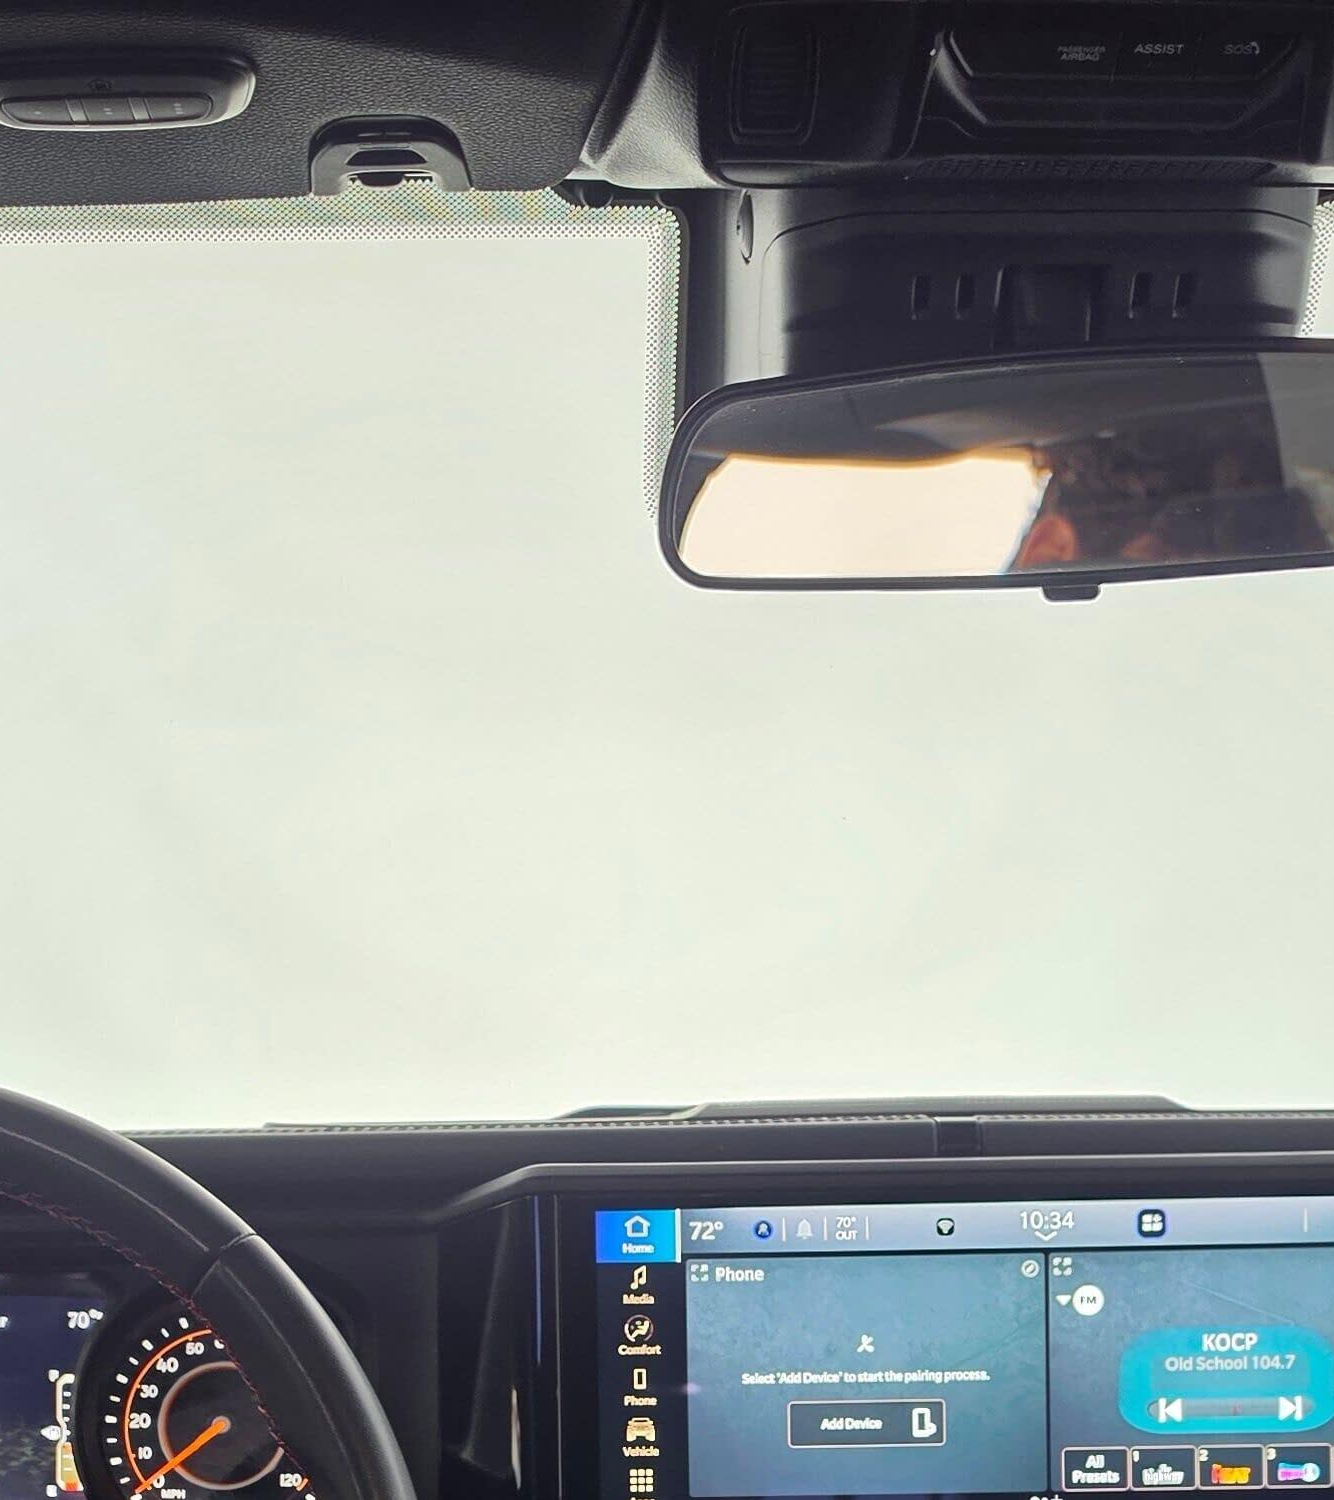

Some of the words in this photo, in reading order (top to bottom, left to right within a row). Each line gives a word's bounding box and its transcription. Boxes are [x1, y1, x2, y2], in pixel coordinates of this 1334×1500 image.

[1134, 43, 1184, 55] ASSIST
[1223, 43, 1252, 55] SOS
[836, 1216, 857, 1228] 70°
[1020, 1211, 1075, 1231] 10:34
[689, 1220, 724, 1240] 72°
[835, 1230, 858, 1241] OUT
[622, 1243, 655, 1254] Home
[715, 1266, 765, 1282] Phone
[623, 1294, 655, 1305] Media
[1080, 1295, 1097, 1305] FM
[1201, 1332, 1259, 1352] KOCP
[186, 1343, 204, 1355] 50
[617, 1344, 662, 1356] Comfort
[156, 1357, 179, 1373] 40
[1165, 1356, 1194, 1372] Old
[1196, 1355, 1250, 1372] School
[1252, 1354, 1296, 1371] 104.7
[742, 1373, 776, 1385] Select
[844, 1373, 856, 1383] to
[858, 1371, 882, 1383] start
[885, 1371, 903, 1383] the
[904, 1370, 942, 1384] pairing
[140, 1384, 159, 1399] 30
[623, 1394, 657, 1408] Phone
[129, 1412, 152, 1429] 20
[820, 1417, 843, 1430] Add
[845, 1417, 883, 1430] Device
[138, 1446, 153, 1460] 10
[622, 1446, 660, 1458] Vehicle
[1132, 1450, 1140, 1463] 1
[1199, 1449, 1210, 1462] 2
[1267, 1448, 1277, 1461] 3
[1086, 1454, 1105, 1469] All
[280, 1474, 302, 1488] 120
[1072, 1470, 1120, 1484] Presets
[161, 1488, 186, 1500] MPH
